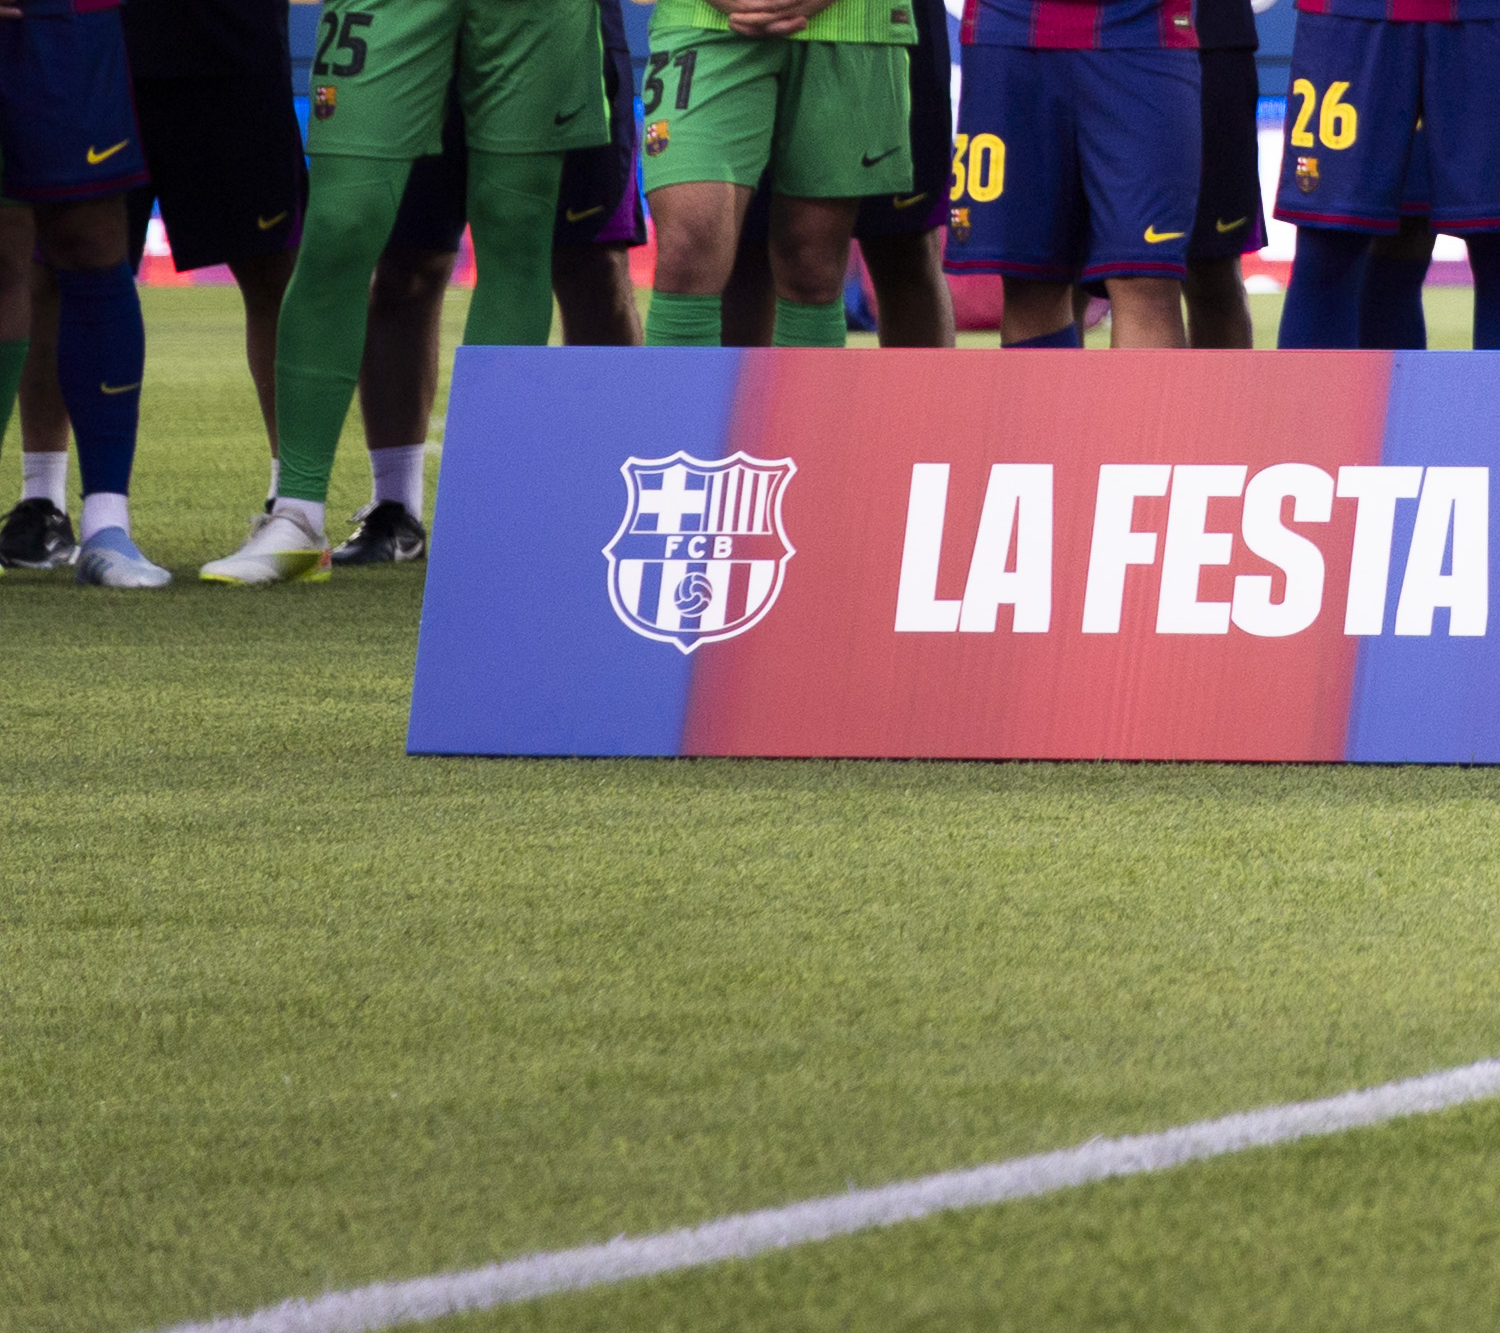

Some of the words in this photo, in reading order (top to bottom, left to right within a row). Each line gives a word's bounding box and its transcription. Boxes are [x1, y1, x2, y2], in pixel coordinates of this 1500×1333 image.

[313, 10, 374, 77] 25
[643, 50, 697, 116] 31
[1290, 78, 1357, 150] 26
[949, 133, 1006, 202] 30
[664, 535, 733, 558] FCB
[895, 464, 1053, 633] LA
[1082, 463, 1490, 637] FESTA
